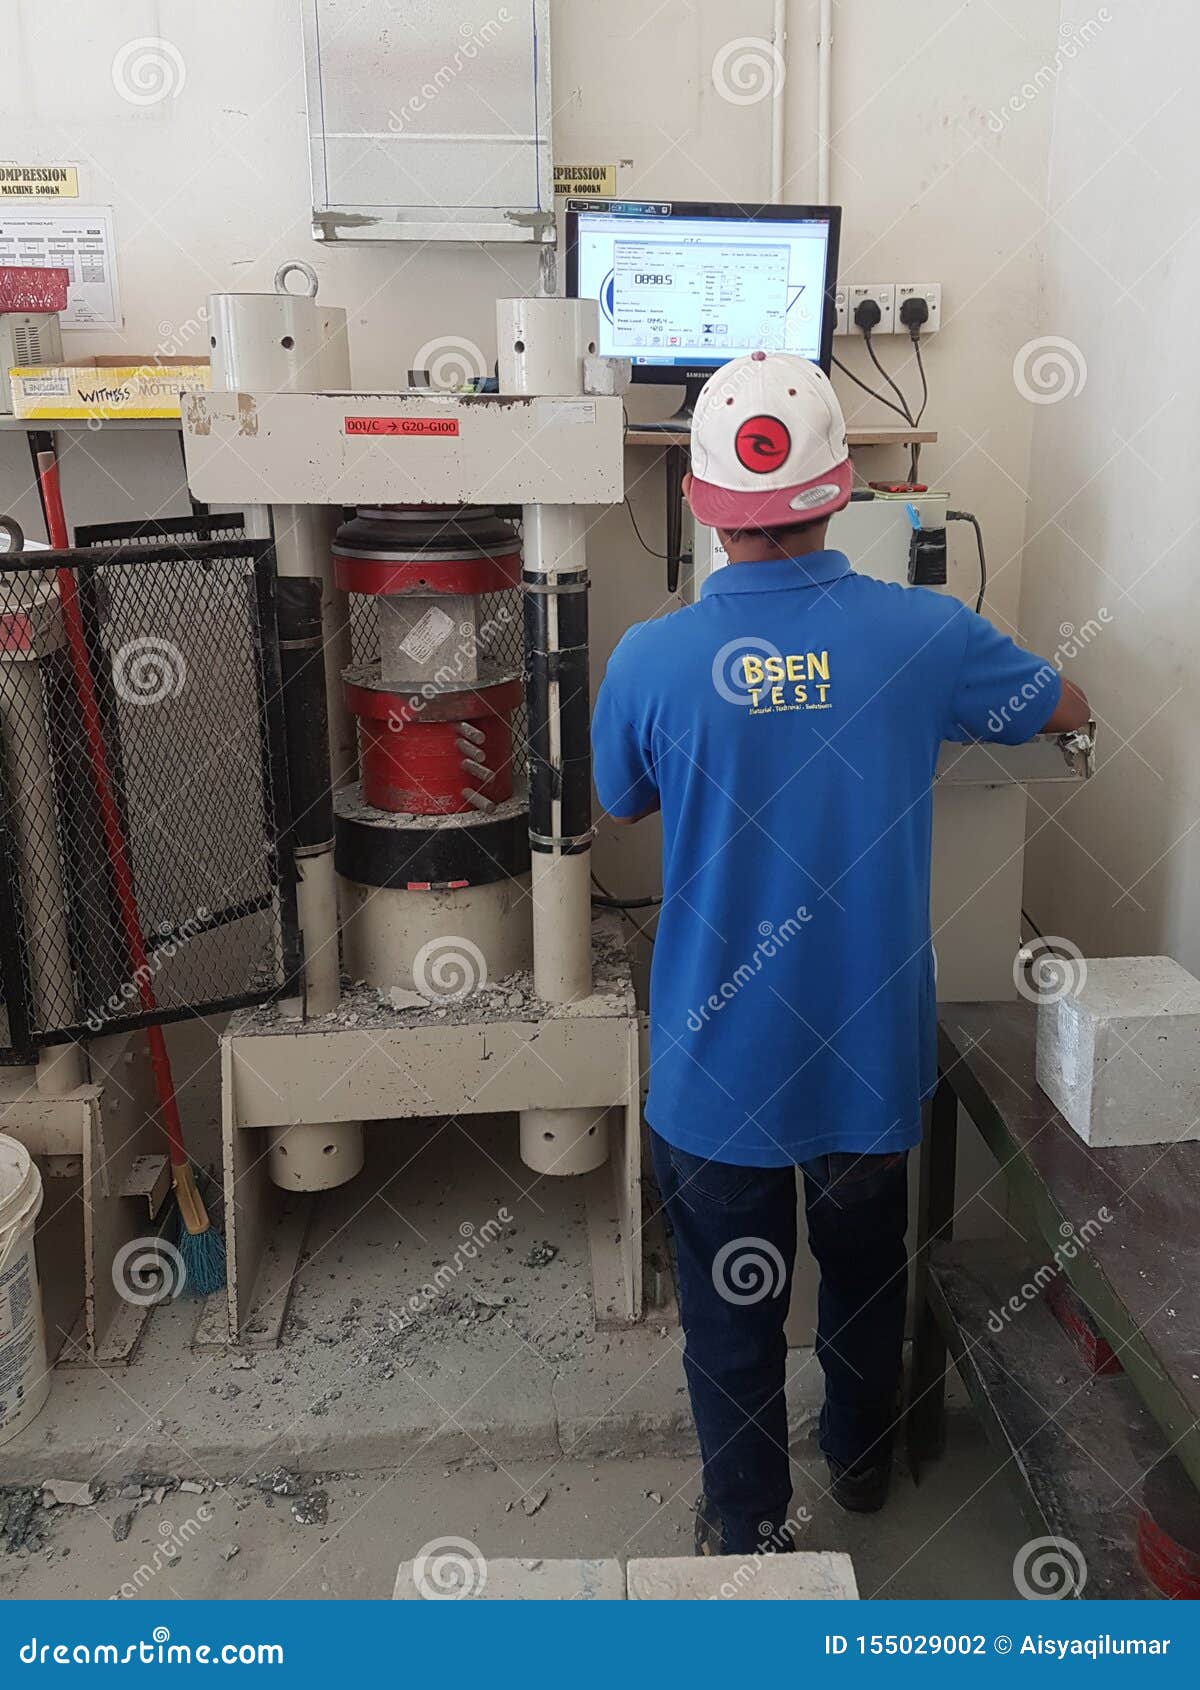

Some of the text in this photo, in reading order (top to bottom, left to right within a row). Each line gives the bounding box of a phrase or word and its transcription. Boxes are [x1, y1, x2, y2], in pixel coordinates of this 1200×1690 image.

[0, 169, 67, 181] OMPRESSION
[553, 167, 607, 180] PRESSION
[1, 185, 33, 194] MACHINE
[554, 184, 571, 193] HINE
[634, 273, 673, 286] 0898.5
[78, 387, 131, 403] WITNESS
[347, 420, 379, 432] 001/C
[742, 651, 830, 684] BSEN
[748, 684, 831, 707] TEST
